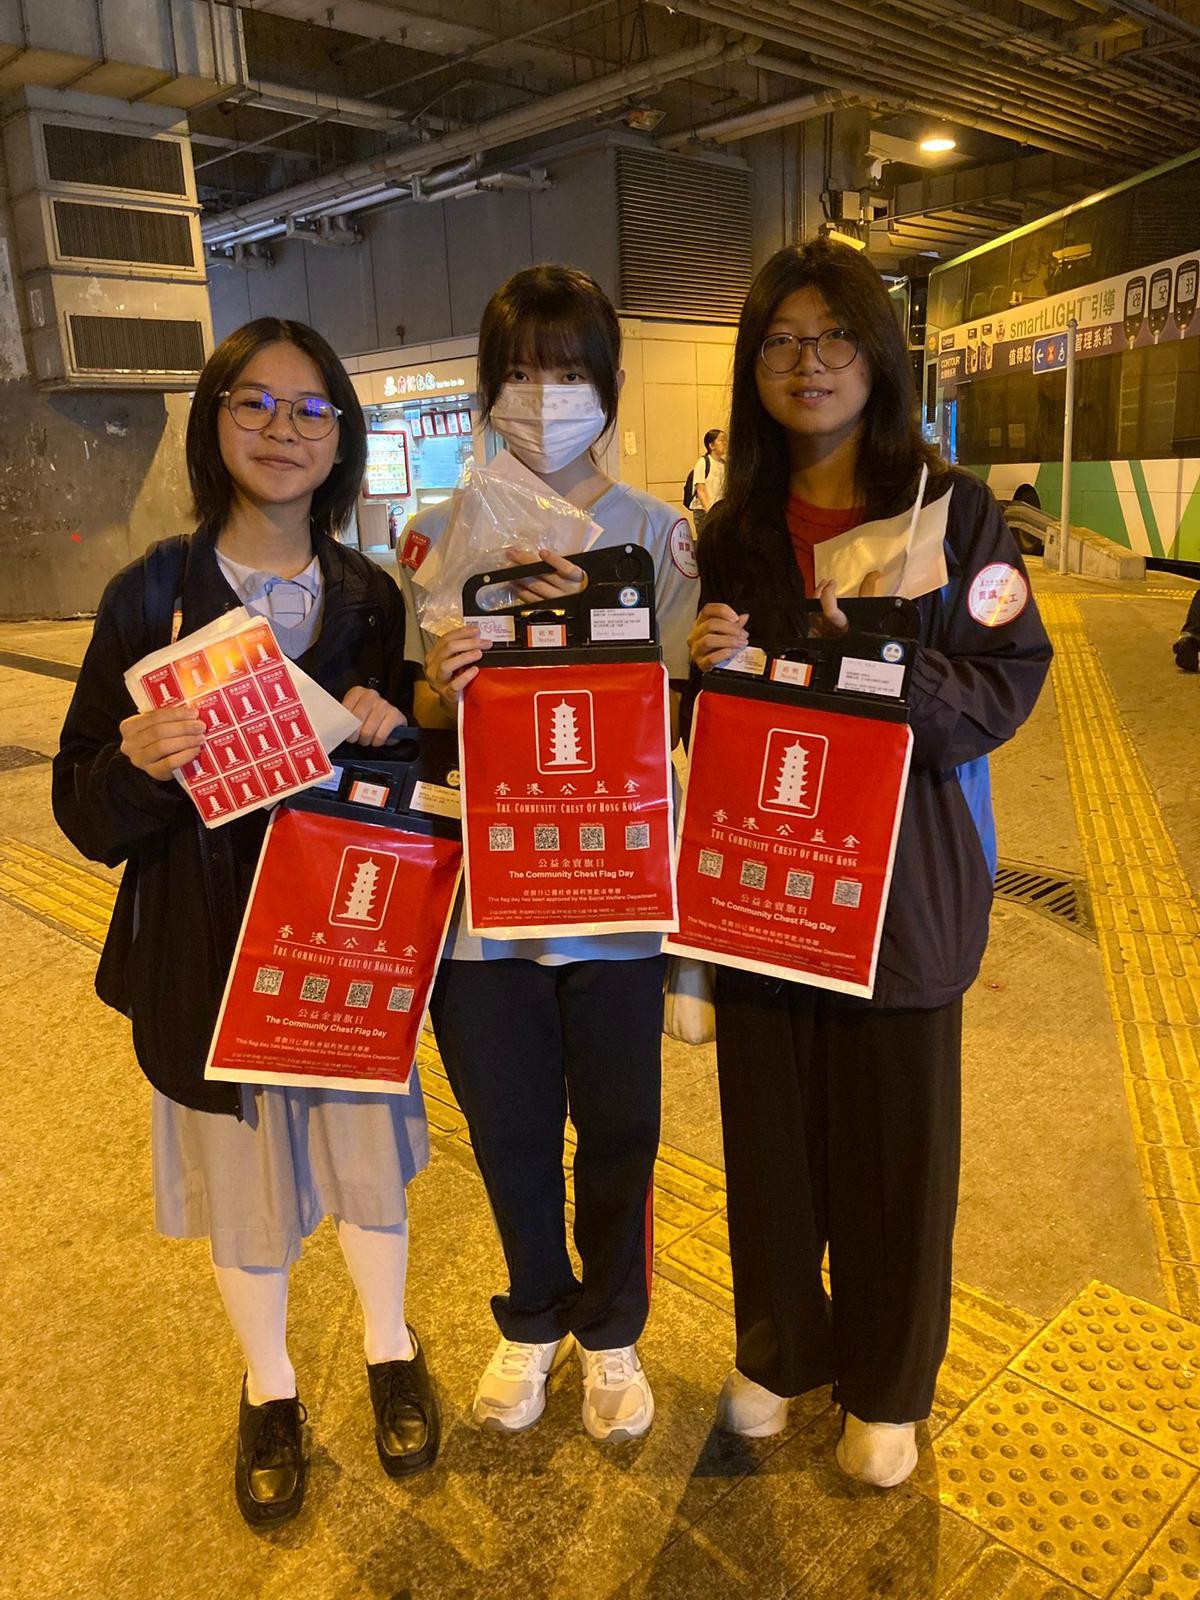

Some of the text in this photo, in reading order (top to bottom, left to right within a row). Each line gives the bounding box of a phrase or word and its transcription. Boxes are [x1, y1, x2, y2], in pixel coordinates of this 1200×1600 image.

[1091, 287, 1116, 320] 引導
[1008, 345, 1034, 366] 值得您
[496, 780, 640, 796] 香港公益金
[496, 802, 640, 813] THE COMMUNITY CHEST OF HONG KONG
[712, 809, 860, 848] 香港公益金
[711, 828, 724, 840] THE
[728, 832, 769, 852] COMMUNITY
[773, 844, 798, 856] CHEST
[800, 848, 810, 860] OF
[812, 850, 834, 864] HONG
[836, 855, 858, 867] KONG
[508, 869, 634, 880] The Community Chest Flag Day
[710, 896, 837, 934] The Community Chest Flag Day
[278, 924, 418, 957] 香港公益金
[273, 944, 414, 974] THE COMMUNITY CHEST OF HONG KONG
[266, 1015, 388, 1038] The Community Chest Flag Day
